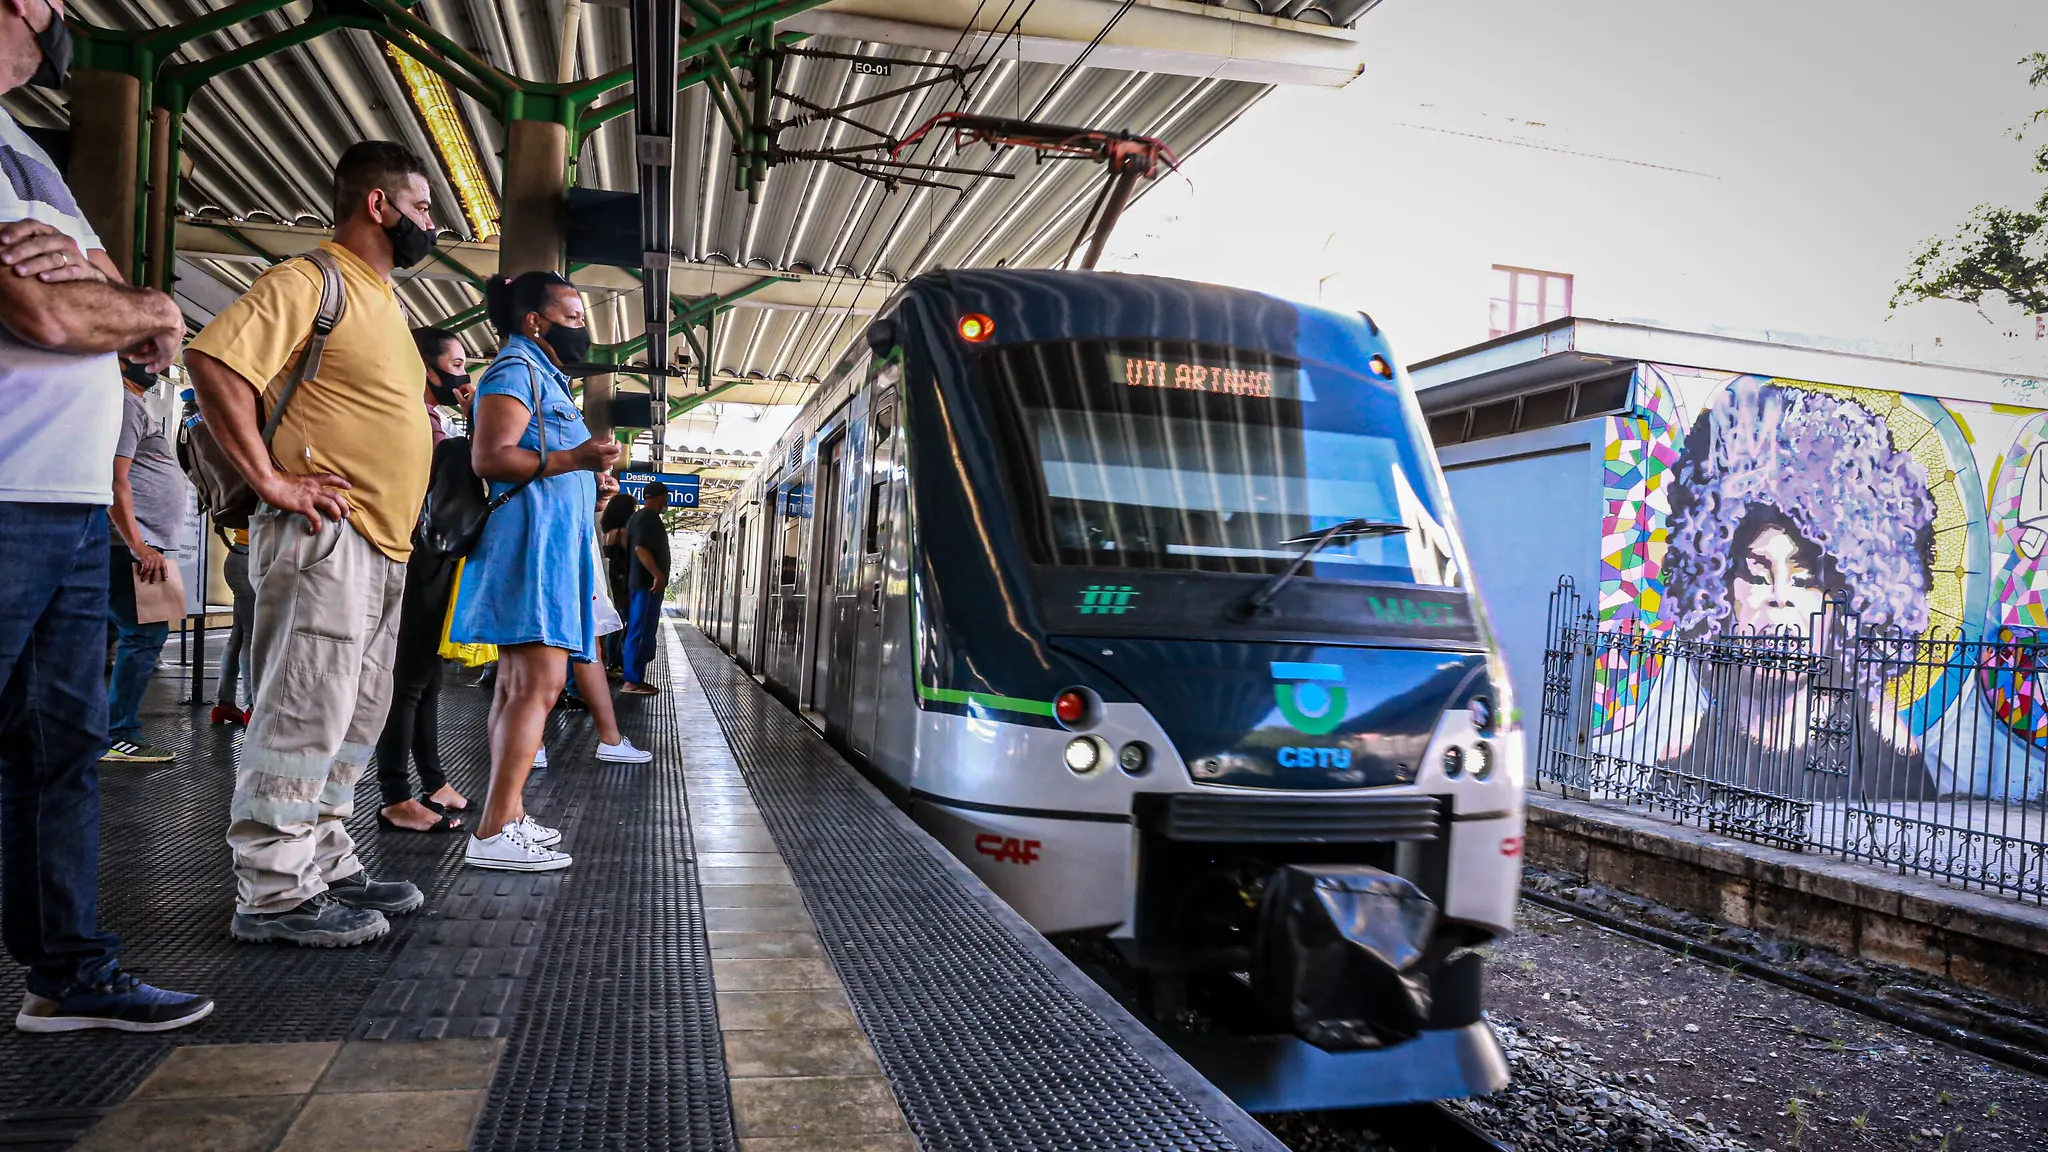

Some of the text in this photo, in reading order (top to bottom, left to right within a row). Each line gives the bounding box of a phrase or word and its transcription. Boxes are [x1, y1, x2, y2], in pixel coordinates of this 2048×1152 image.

[855, 62, 888, 75] EO-01
[626, 472, 656, 482] Destino
[626, 486, 694, 504] Vilnho
[1277, 746, 1352, 769] CBTU
[974, 833, 1042, 866] CAF
